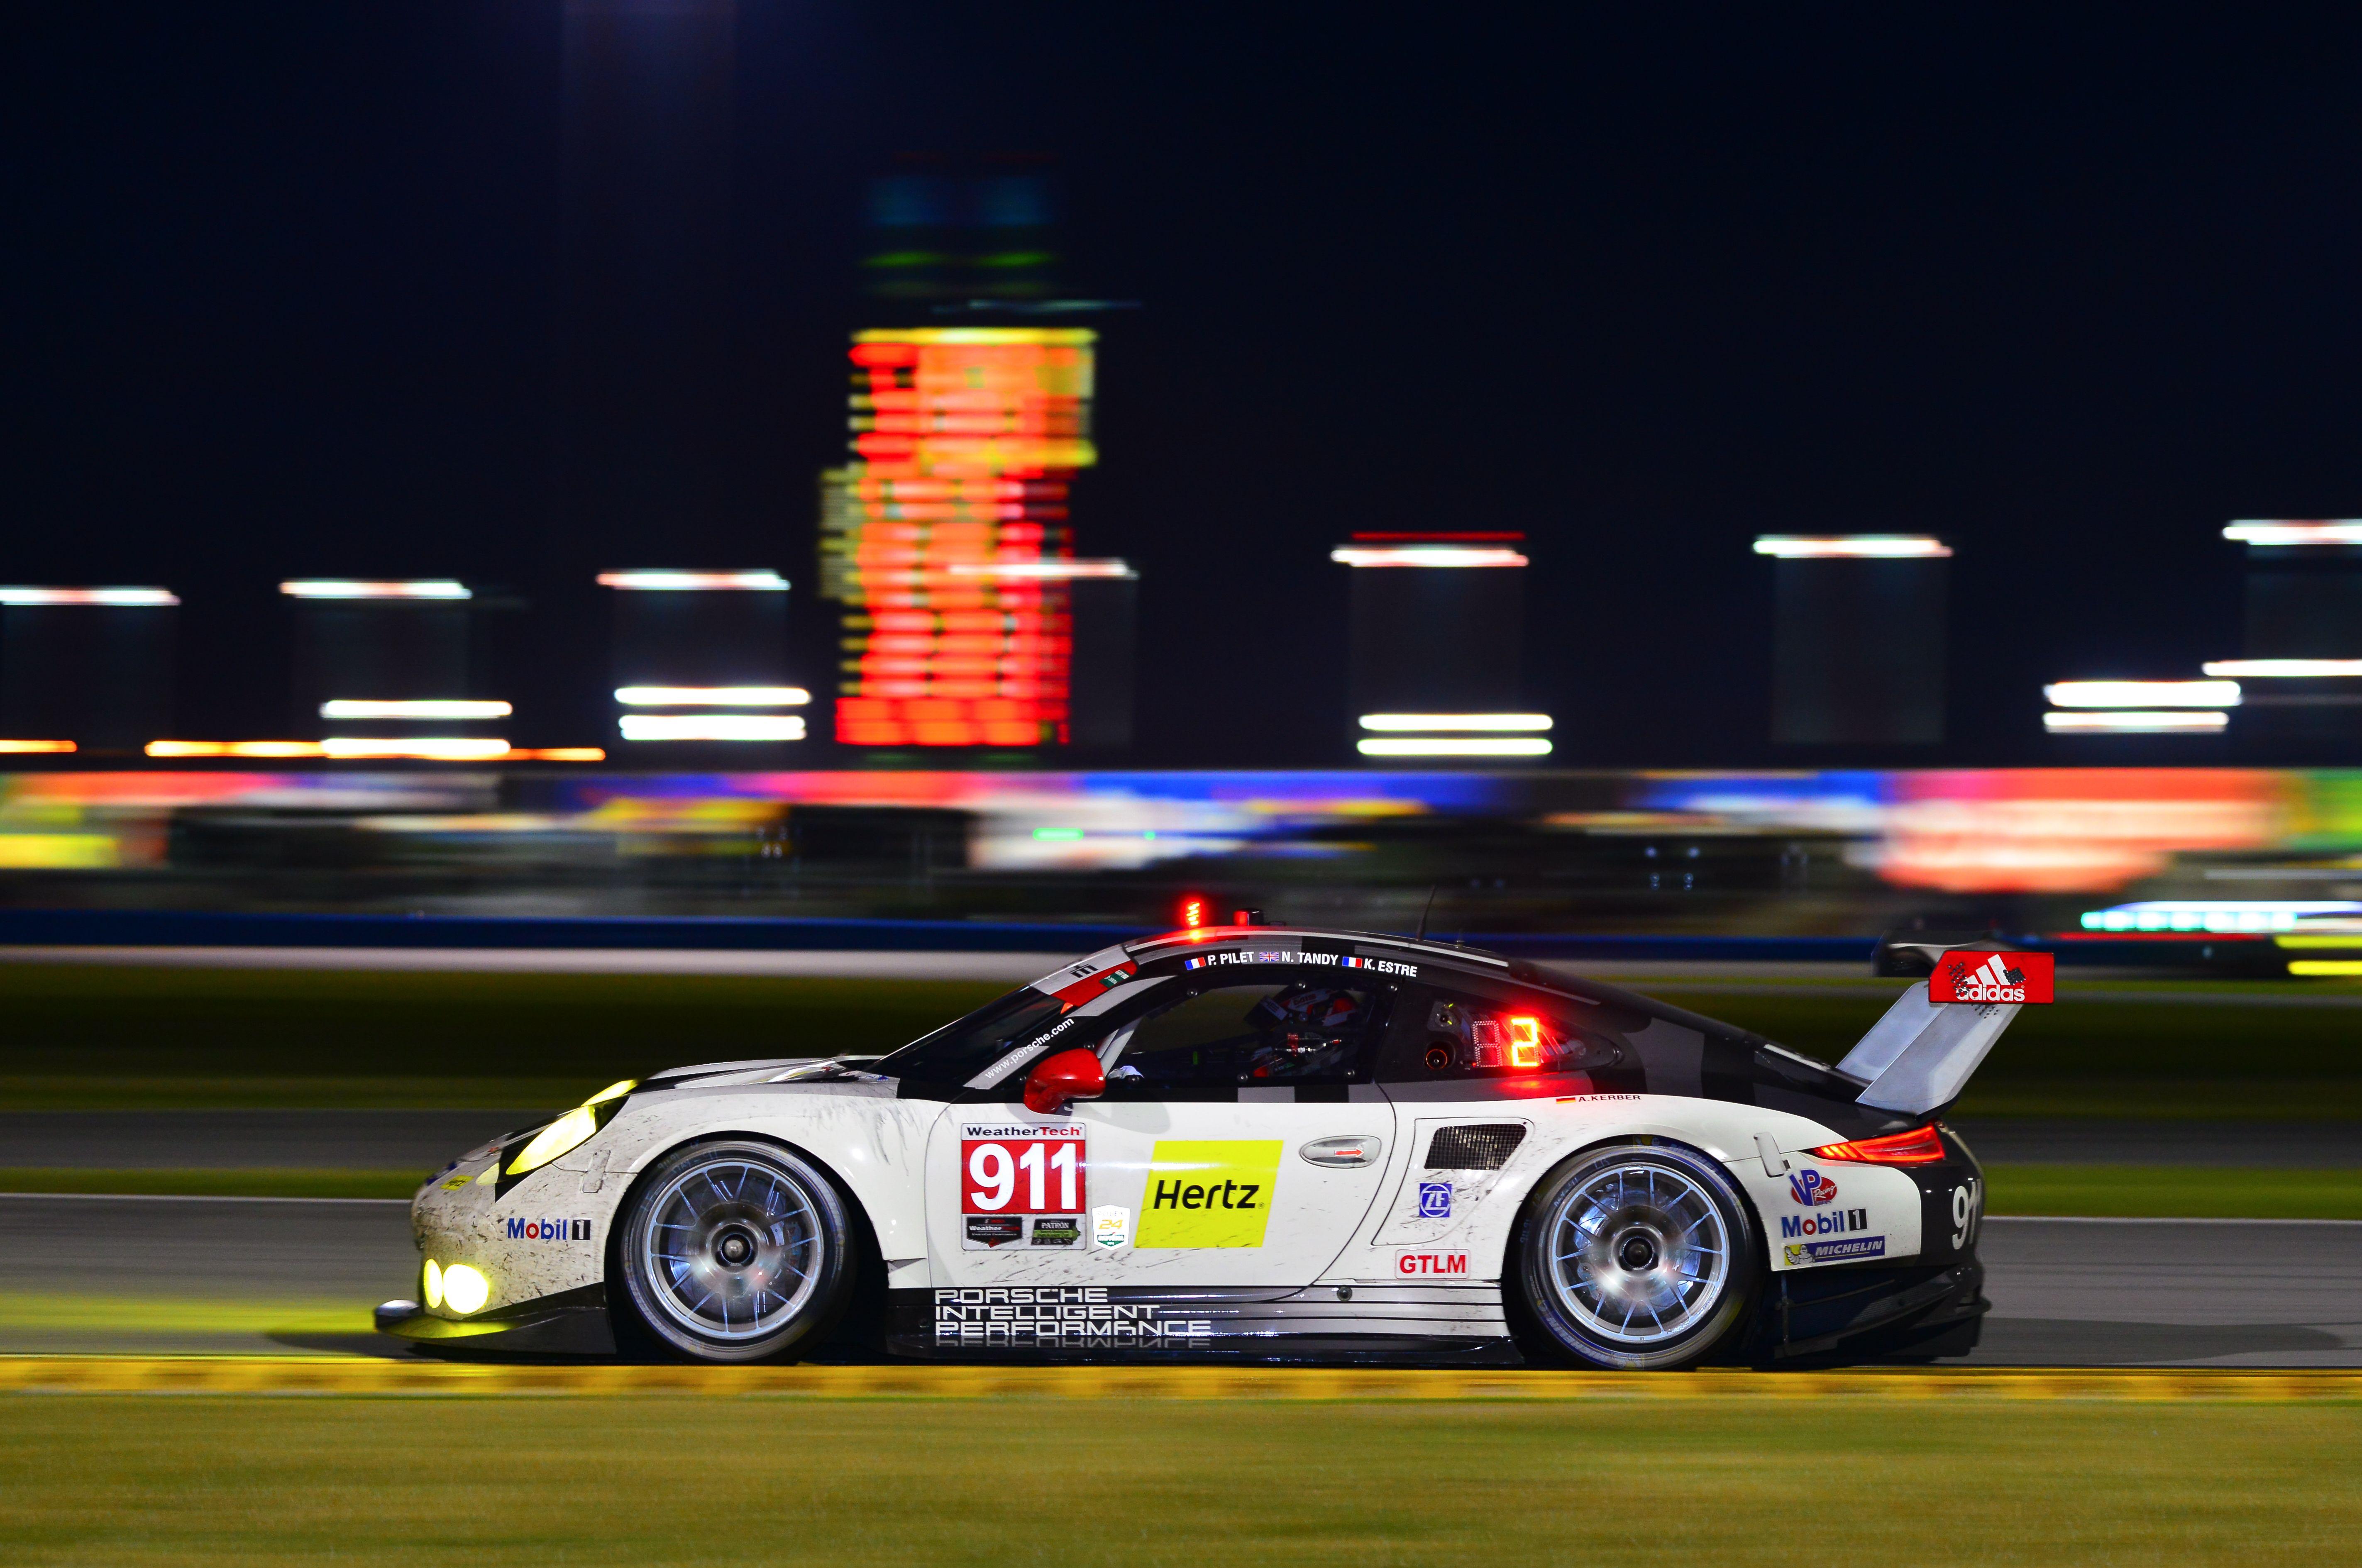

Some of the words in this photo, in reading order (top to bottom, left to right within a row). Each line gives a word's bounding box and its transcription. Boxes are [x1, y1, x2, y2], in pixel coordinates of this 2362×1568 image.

[1207, 955, 1216, 966] P.
[1220, 951, 1254, 964] PILET
[1282, 951, 1294, 962] N.
[1297, 952, 1339, 965] TANDY
[1364, 958, 1375, 970] K.
[1378, 961, 1417, 977] ESTRE
[1956, 984, 2025, 1002] adidas
[985, 1018, 1074, 1079] www.porsche.com
[967, 1127, 1080, 1136] WeatherTech
[969, 1143, 1076, 1211] 911
[1153, 1180, 1259, 1209] Hertz
[1789, 1169, 1821, 1206] VP
[1422, 1190, 1450, 1210] ZF
[508, 1218, 567, 1240] Mobil
[1099, 1219, 1123, 1229] 24
[1781, 1211, 1844, 1238] Mobil
[1816, 1241, 1882, 1256] MICHELIN
[1400, 1255, 1466, 1274] GTLM
[936, 1288, 1107, 1304] PORSCHE
[936, 1305, 1160, 1320] INTELLIGENT
[936, 1320, 1211, 1336] PERFORMANCE
